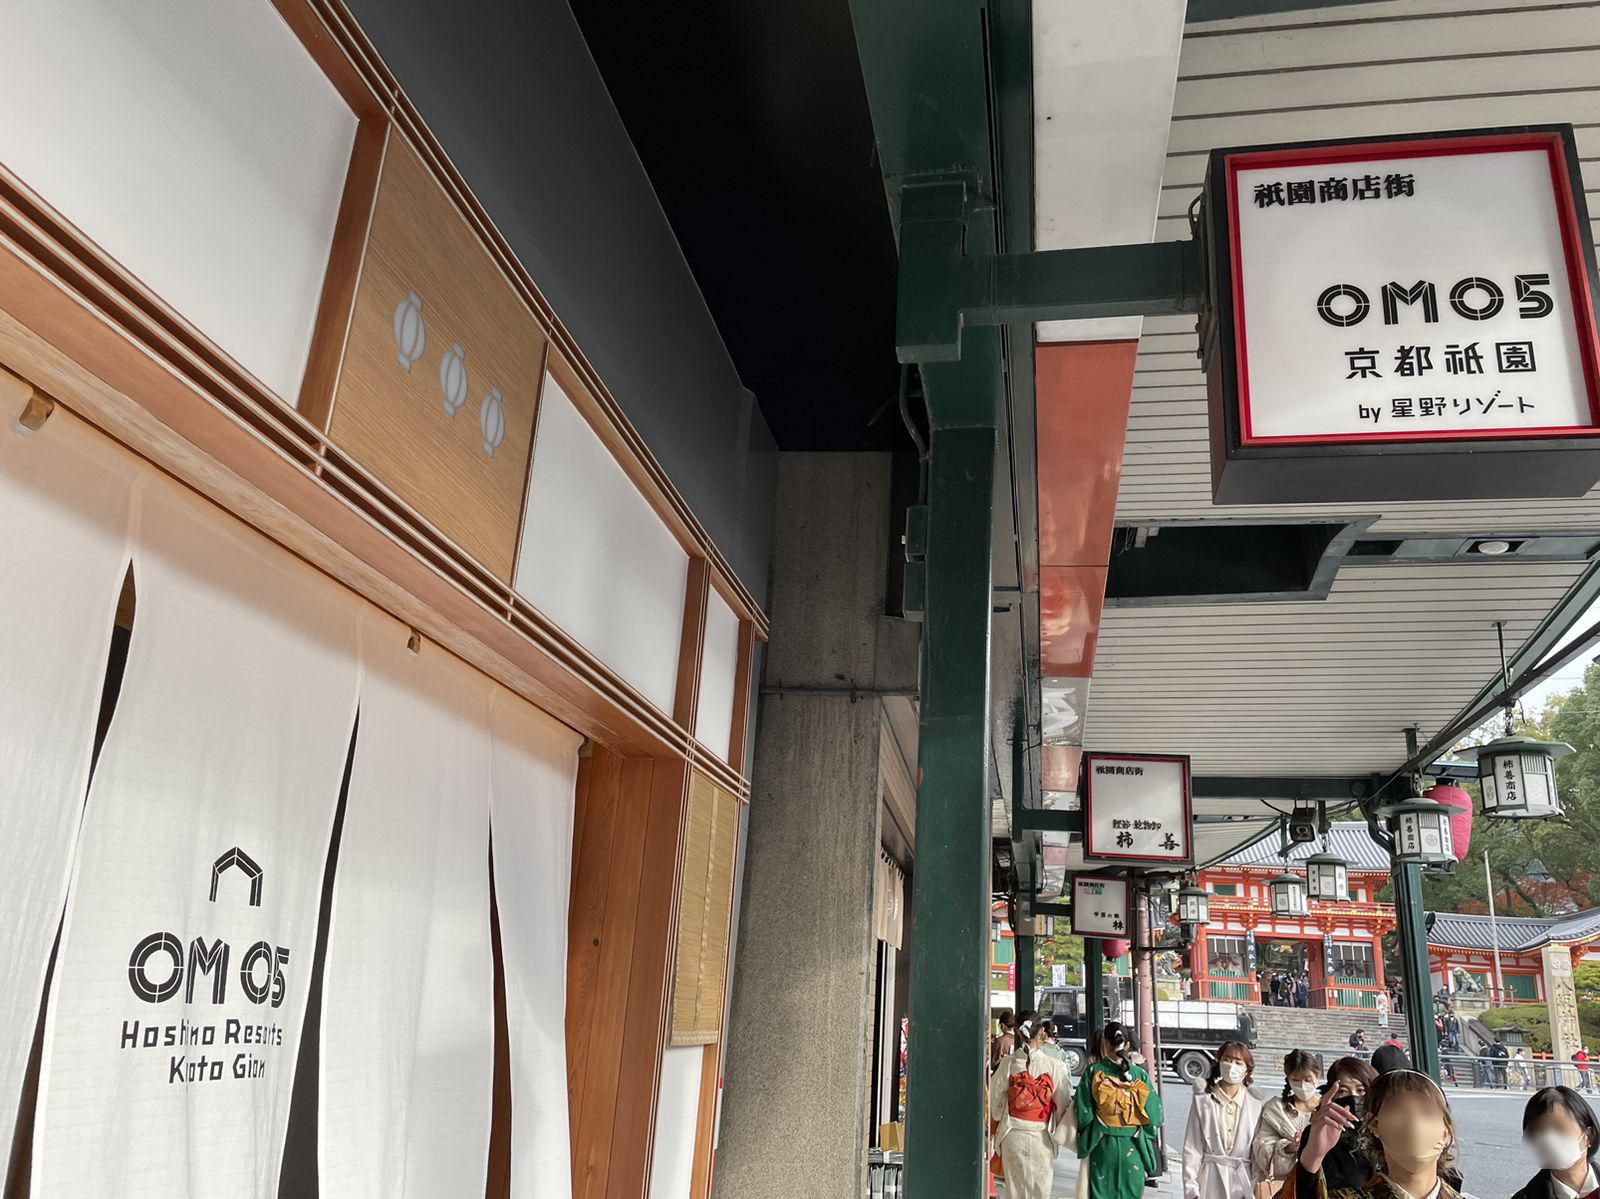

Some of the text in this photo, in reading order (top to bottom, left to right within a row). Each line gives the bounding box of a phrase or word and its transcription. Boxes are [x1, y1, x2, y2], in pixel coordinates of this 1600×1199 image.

[1254, 173, 1415, 208] 祇園商店街
[1317, 274, 1554, 327] OMO5
[1344, 341, 1537, 379] 京都祇園
[1359, 390, 1535, 423] by 星野リゾート
[128, 931, 290, 1009] OMO5
[232, 1053, 266, 1079] Gion
